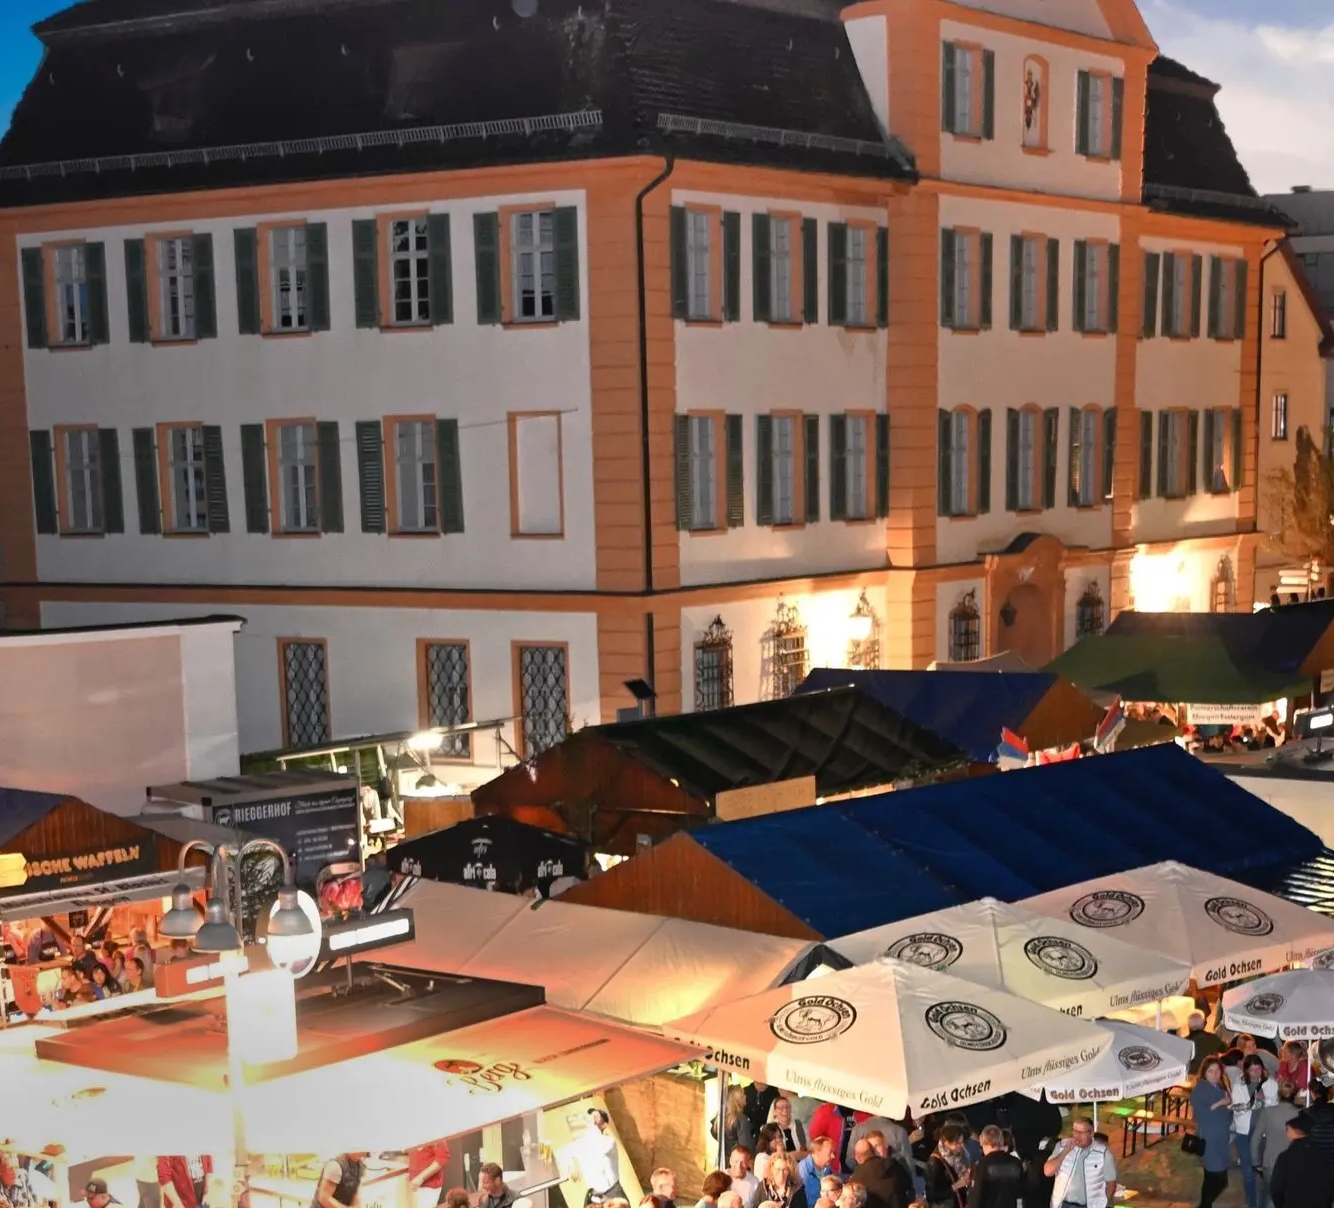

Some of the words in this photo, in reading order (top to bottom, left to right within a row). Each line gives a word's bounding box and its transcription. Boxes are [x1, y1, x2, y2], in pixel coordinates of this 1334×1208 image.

[235, 801, 292, 822] RIEGGERHOF
[73, 845, 141, 871] WAFFELN
[1204, 966, 1228, 982] Gold
[1229, 958, 1263, 977] Ochsen
[798, 996, 826, 1007] Gold
[825, 998, 851, 1020] Ochsen
[1109, 992, 1129, 1008] Ulms
[1283, 1026, 1307, 1037] Gold
[1020, 1065, 1043, 1080] Ulms
[1042, 1056, 1079, 1077] flüssiges
[786, 1069, 812, 1088] Ulms
[859, 1091, 886, 1108] Gold
[920, 1090, 949, 1110] Gold
[950, 1078, 993, 1101] Ochsen
[1050, 1088, 1076, 1101] Gold
[1078, 1086, 1120, 1100] Ochsen
